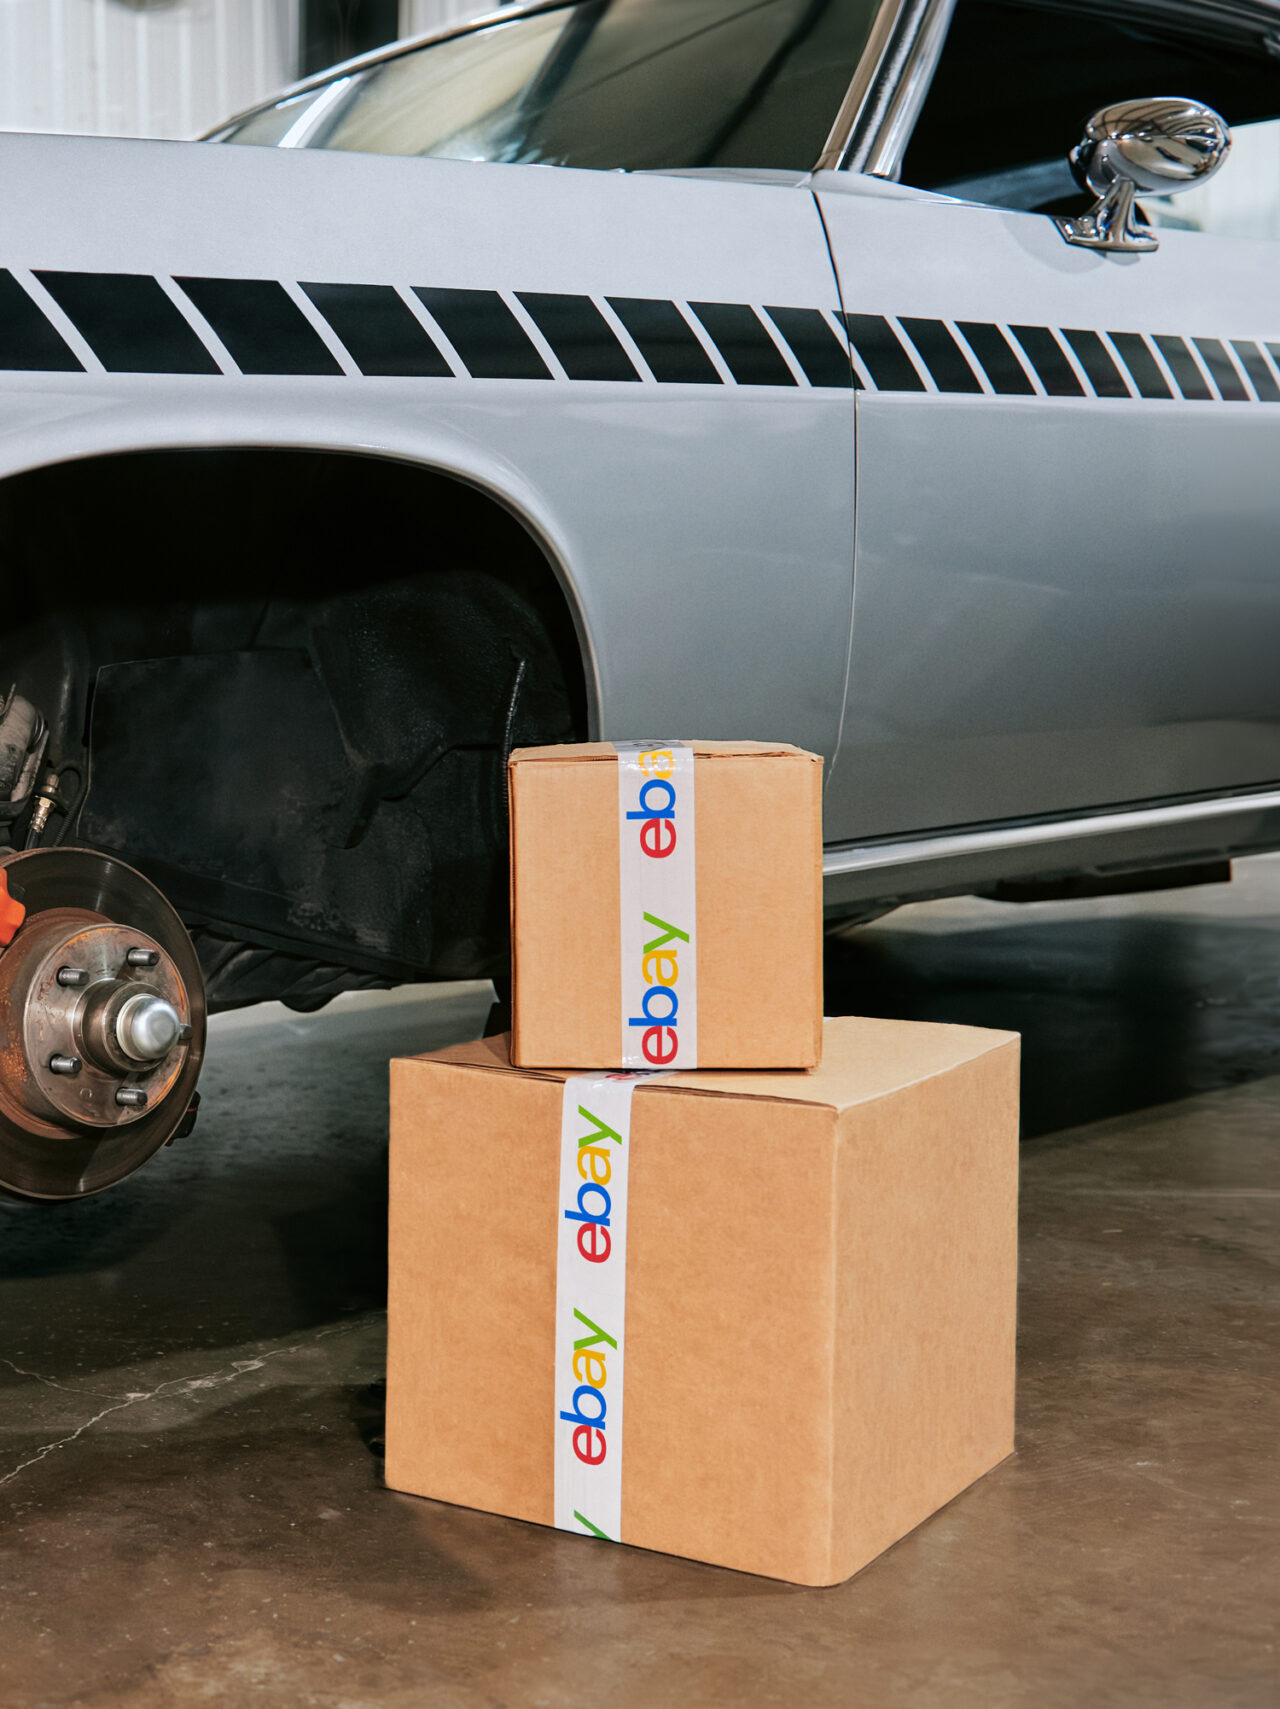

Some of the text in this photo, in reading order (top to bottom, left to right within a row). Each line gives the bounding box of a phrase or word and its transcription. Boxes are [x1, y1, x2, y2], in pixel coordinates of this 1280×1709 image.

[628, 911, 690, 1065] ebay
[565, 1105, 622, 1263] ebay
[560, 1308, 617, 1466] ebay
